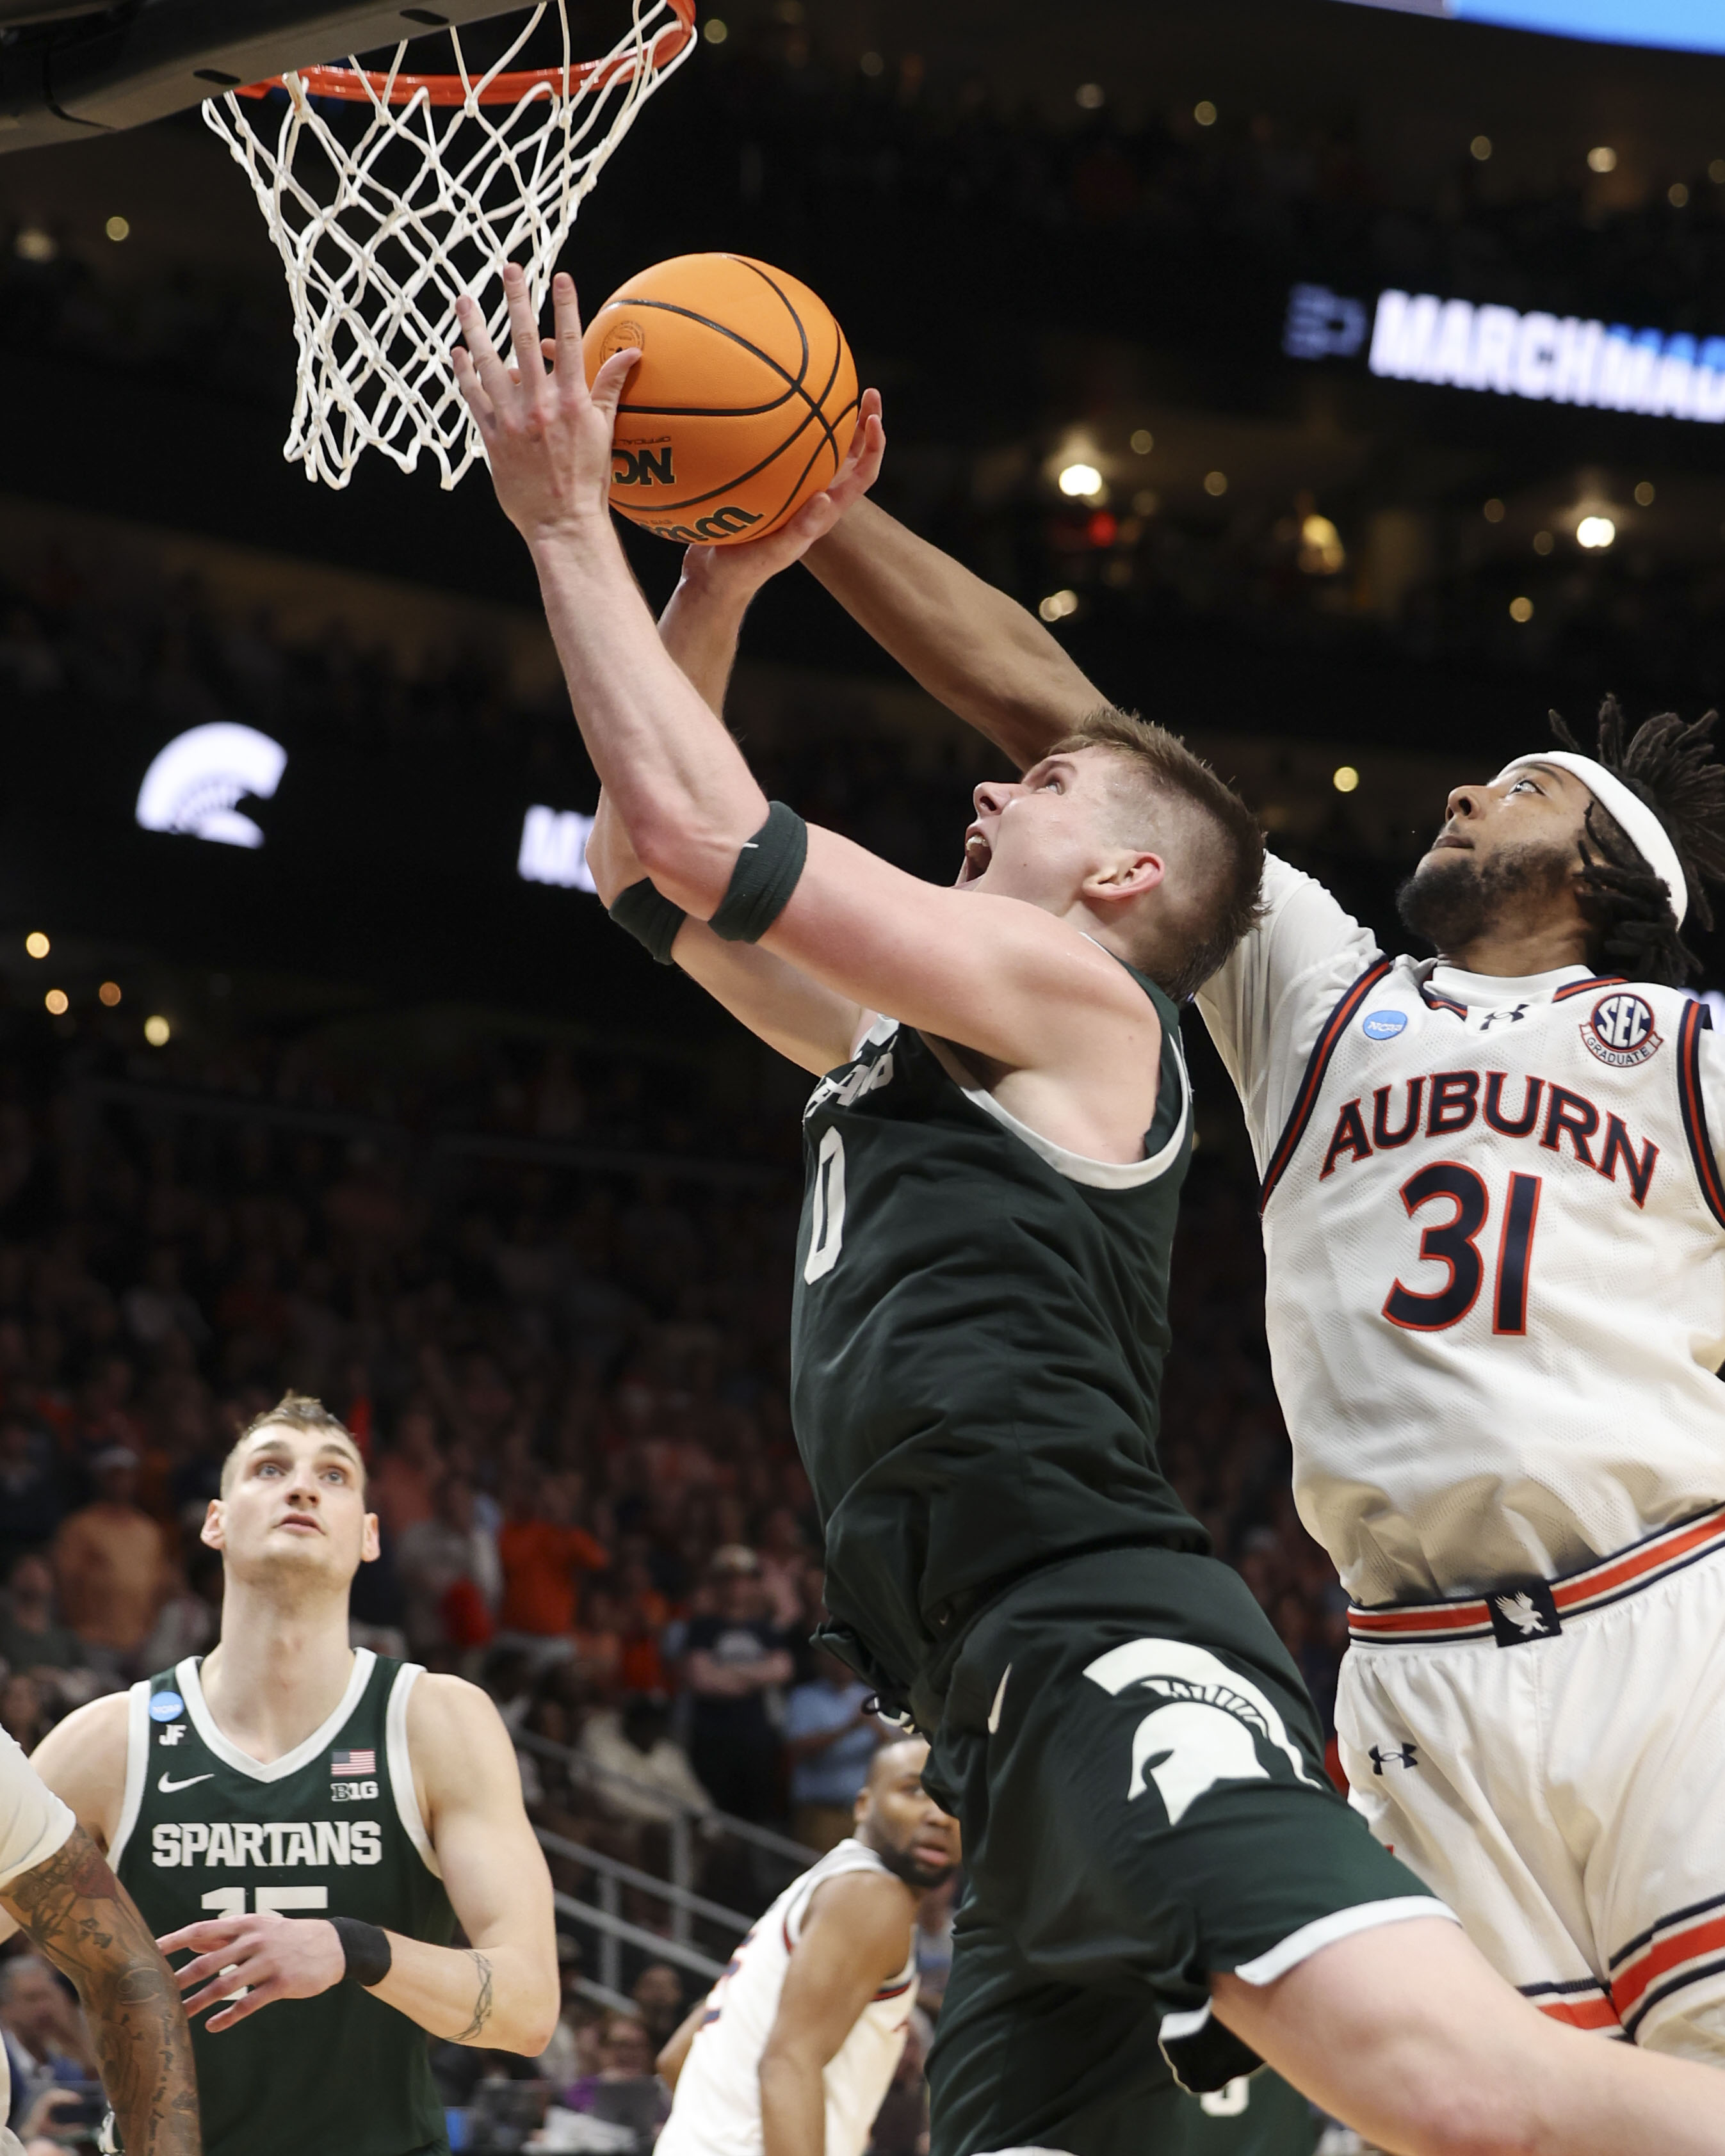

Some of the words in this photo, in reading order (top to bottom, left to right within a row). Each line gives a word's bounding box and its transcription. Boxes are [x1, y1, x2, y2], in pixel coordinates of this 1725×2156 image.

[611, 446, 676, 487] NC
[1596, 995, 1651, 1048] SEC
[1587, 1036, 1651, 1065] GRADUATE
[1319, 1070, 1660, 1209] AUBURN
[1382, 1160, 1543, 1336] 31
[159, 1724, 187, 1746] JF
[152, 1821, 382, 1867] SPARTANS
